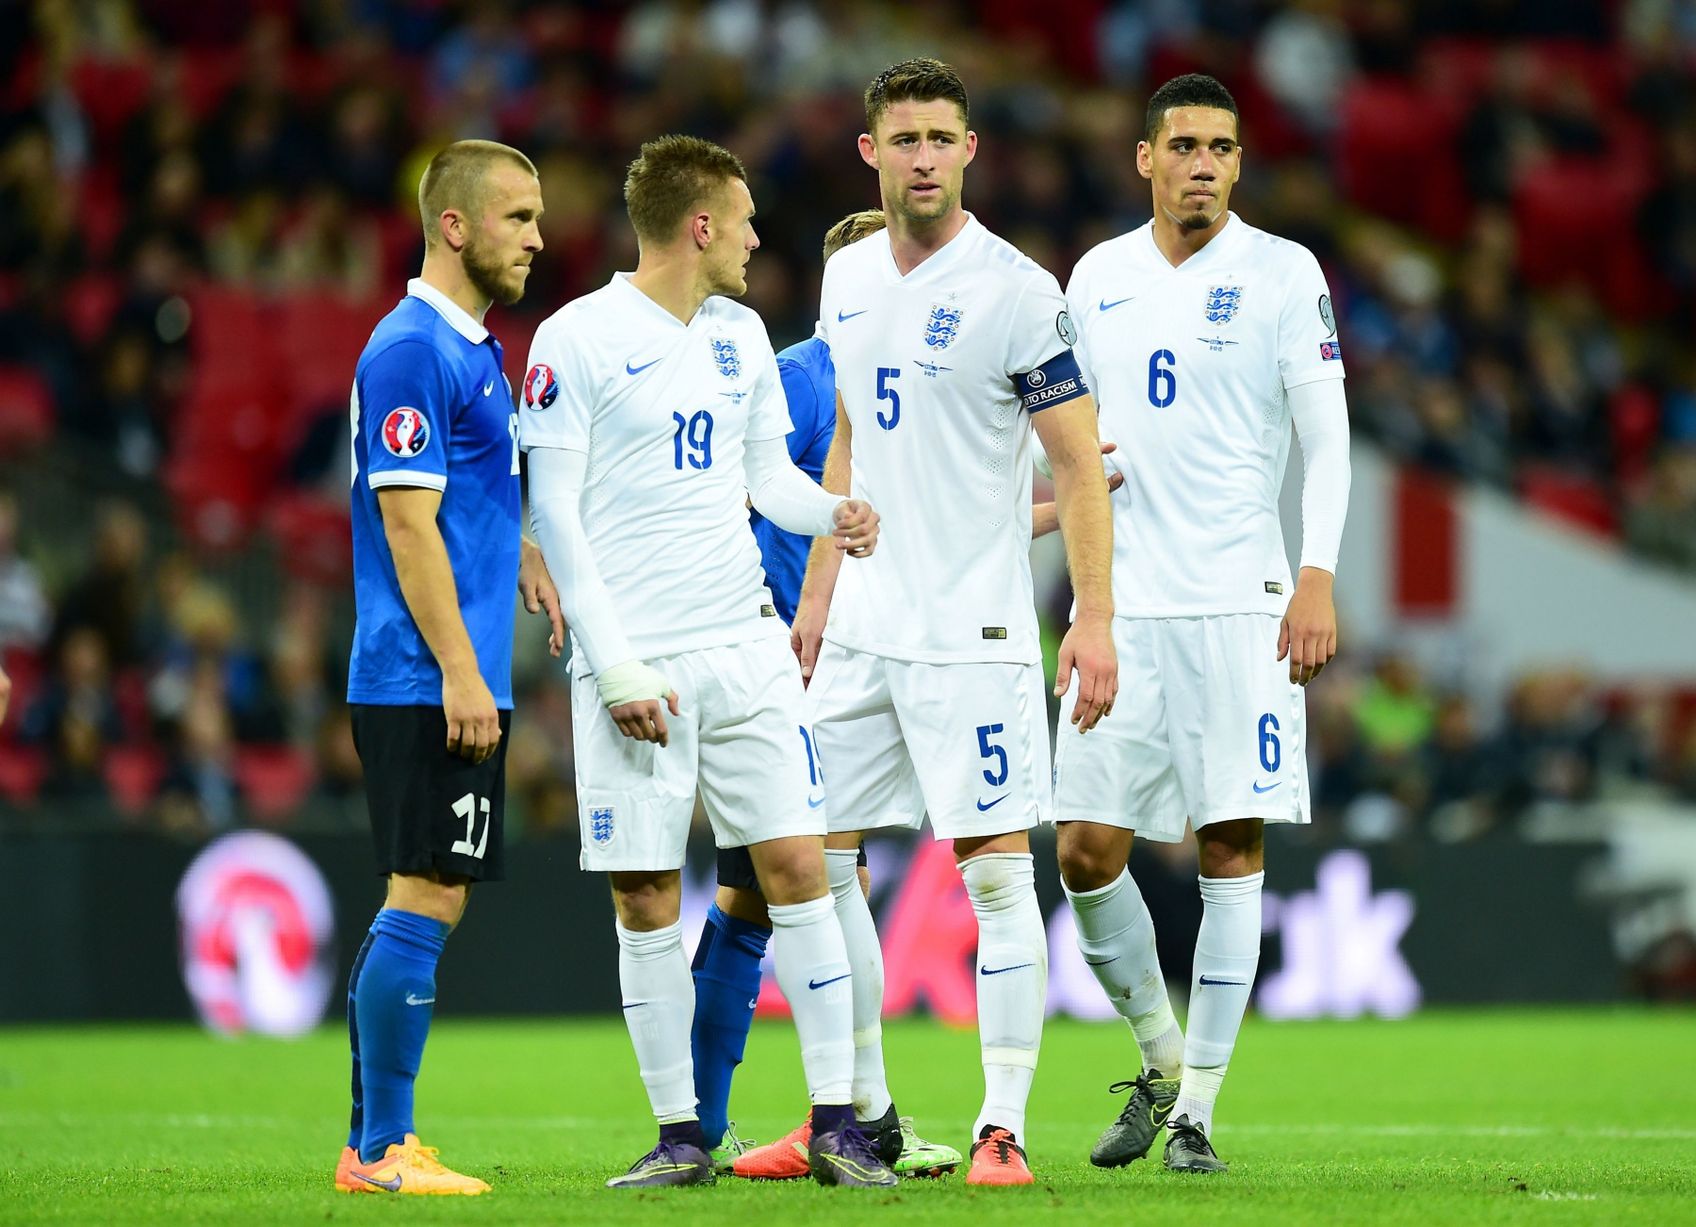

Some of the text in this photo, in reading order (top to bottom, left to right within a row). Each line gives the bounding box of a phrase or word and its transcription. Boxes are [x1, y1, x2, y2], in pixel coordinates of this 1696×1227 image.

[876, 367, 901, 431] 5
[1028, 393, 1040, 405] TO
[1040, 380, 1077, 401] RACISM
[1148, 348, 1177, 409] 6
[673, 409, 714, 470] 19
[976, 723, 1008, 787] 5
[1258, 712, 1281, 773] 6
[451, 792, 491, 860] 17
